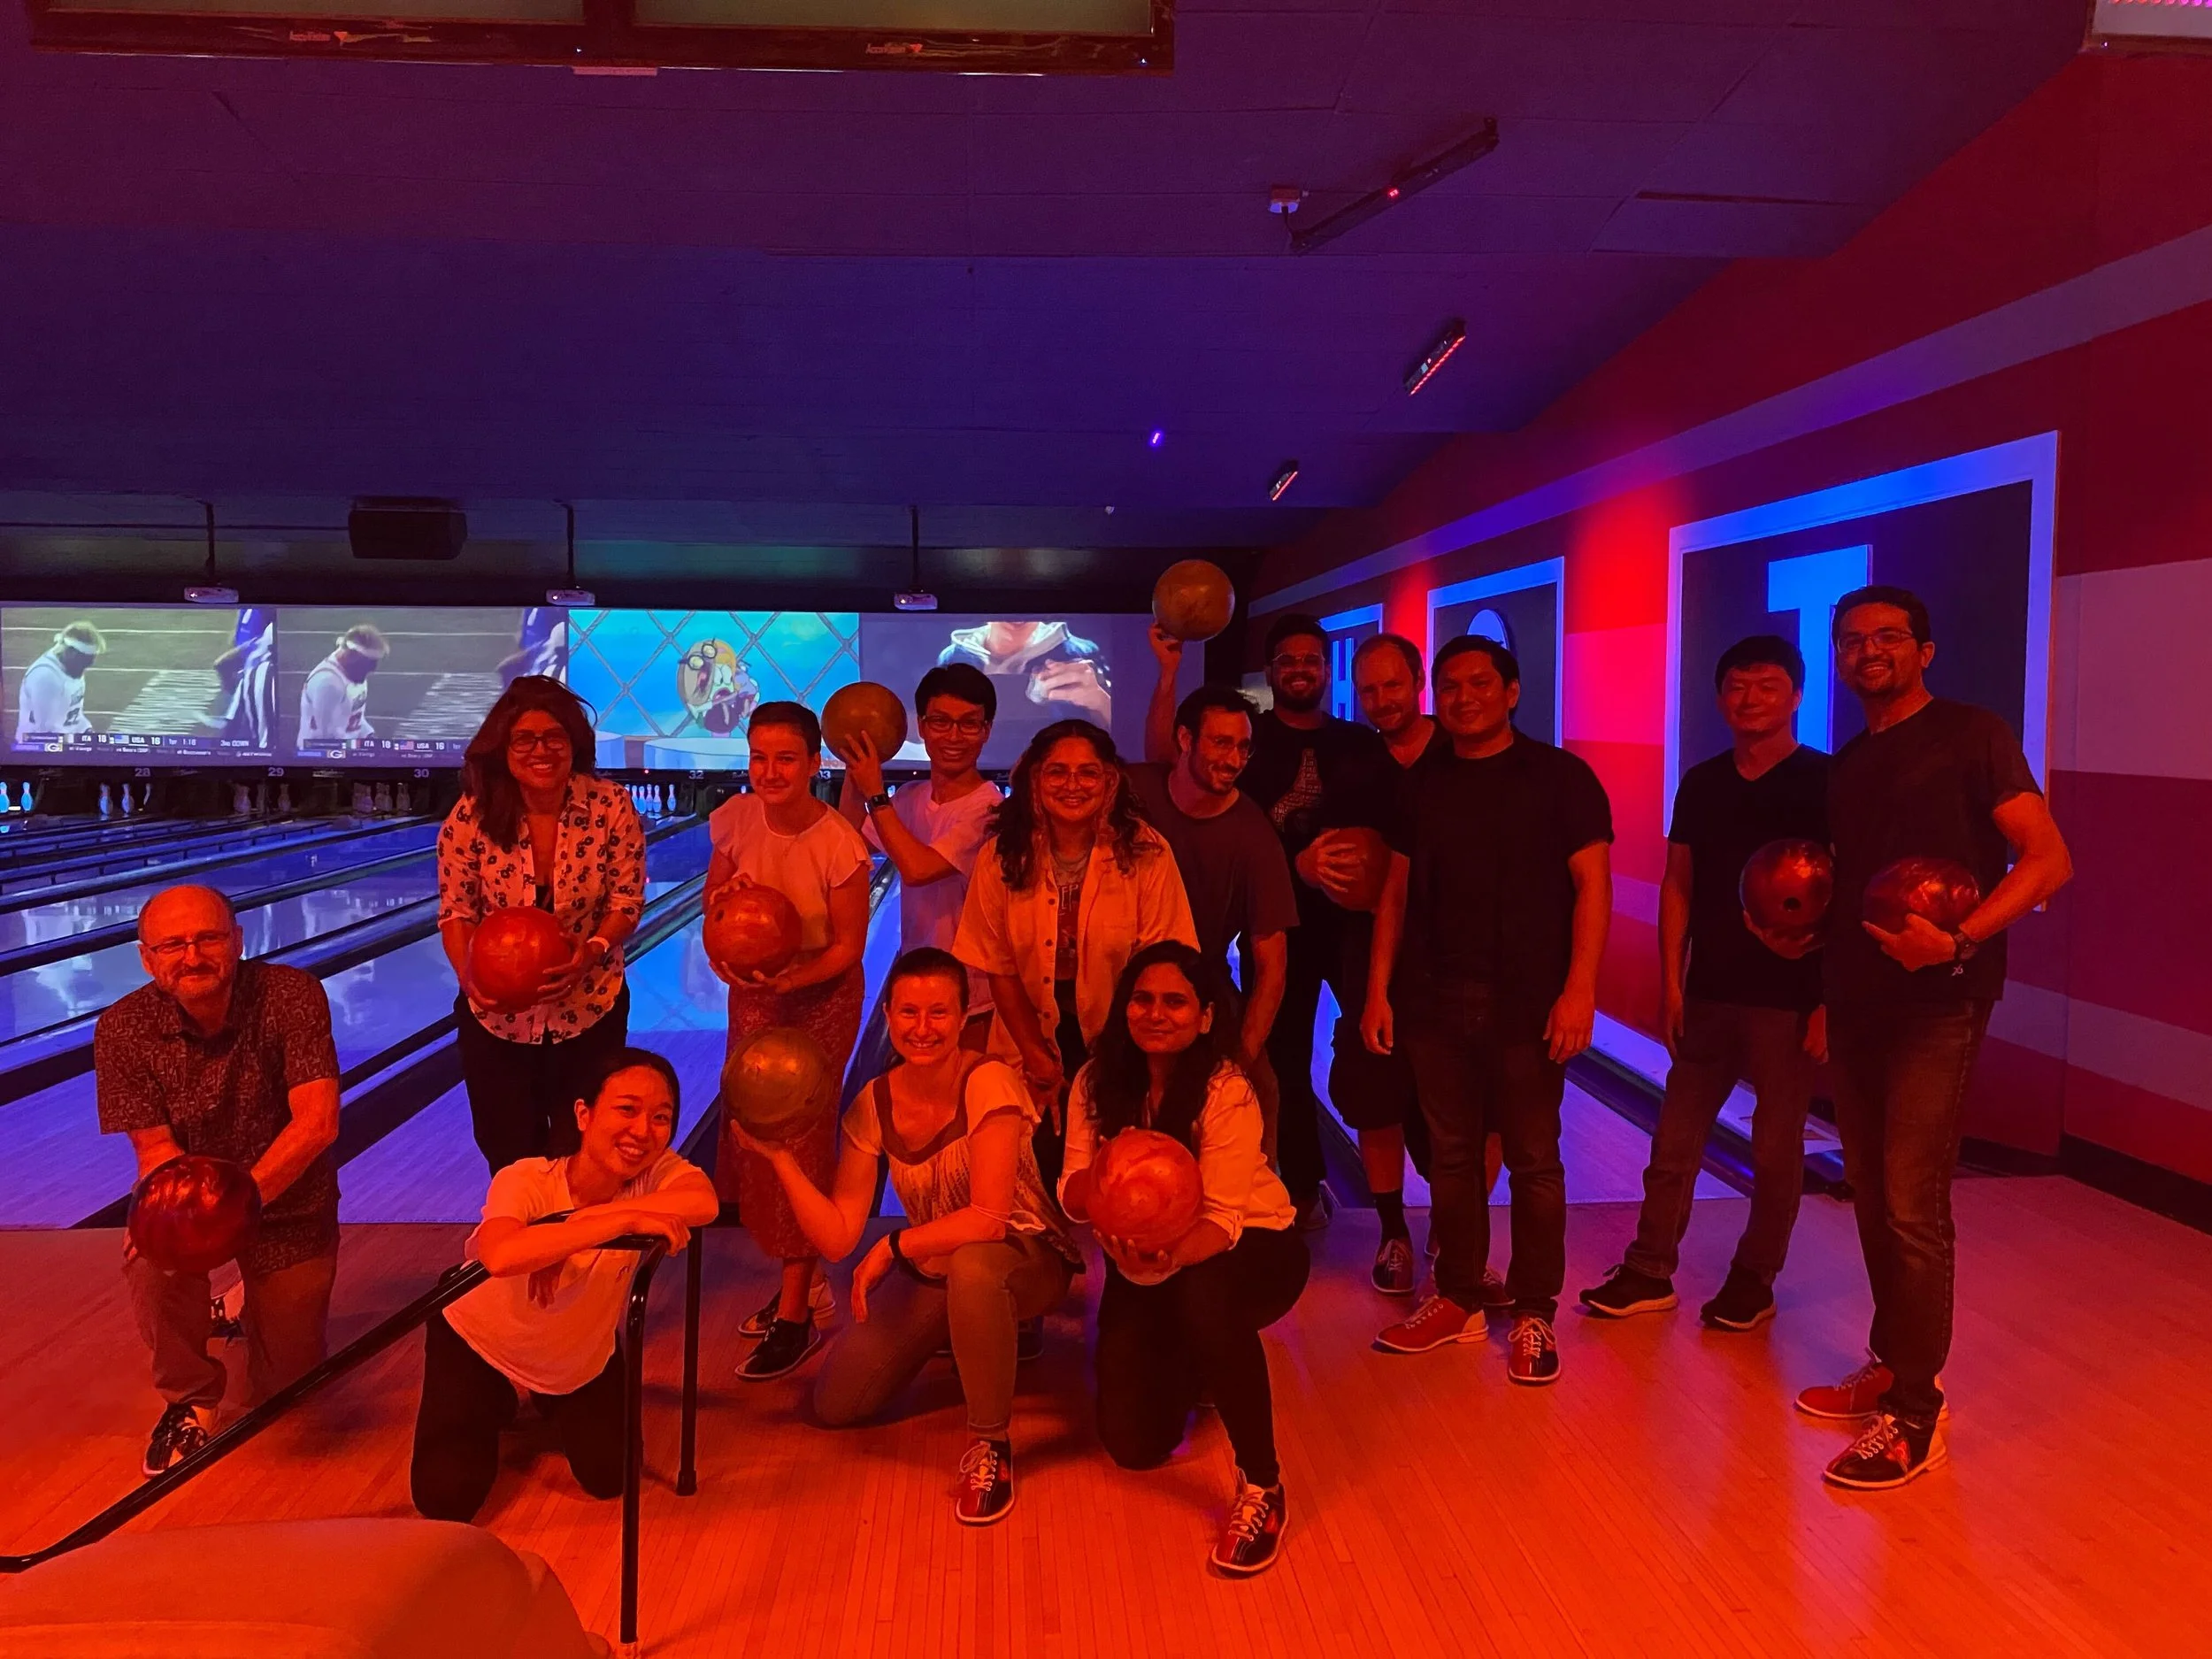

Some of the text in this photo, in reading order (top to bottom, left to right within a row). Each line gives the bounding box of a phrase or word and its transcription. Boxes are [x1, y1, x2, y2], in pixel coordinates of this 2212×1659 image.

[134, 767, 151, 777] 28
[267, 767, 285, 777] 29
[413, 768, 430, 779] 30
[688, 770, 704, 780] 32
